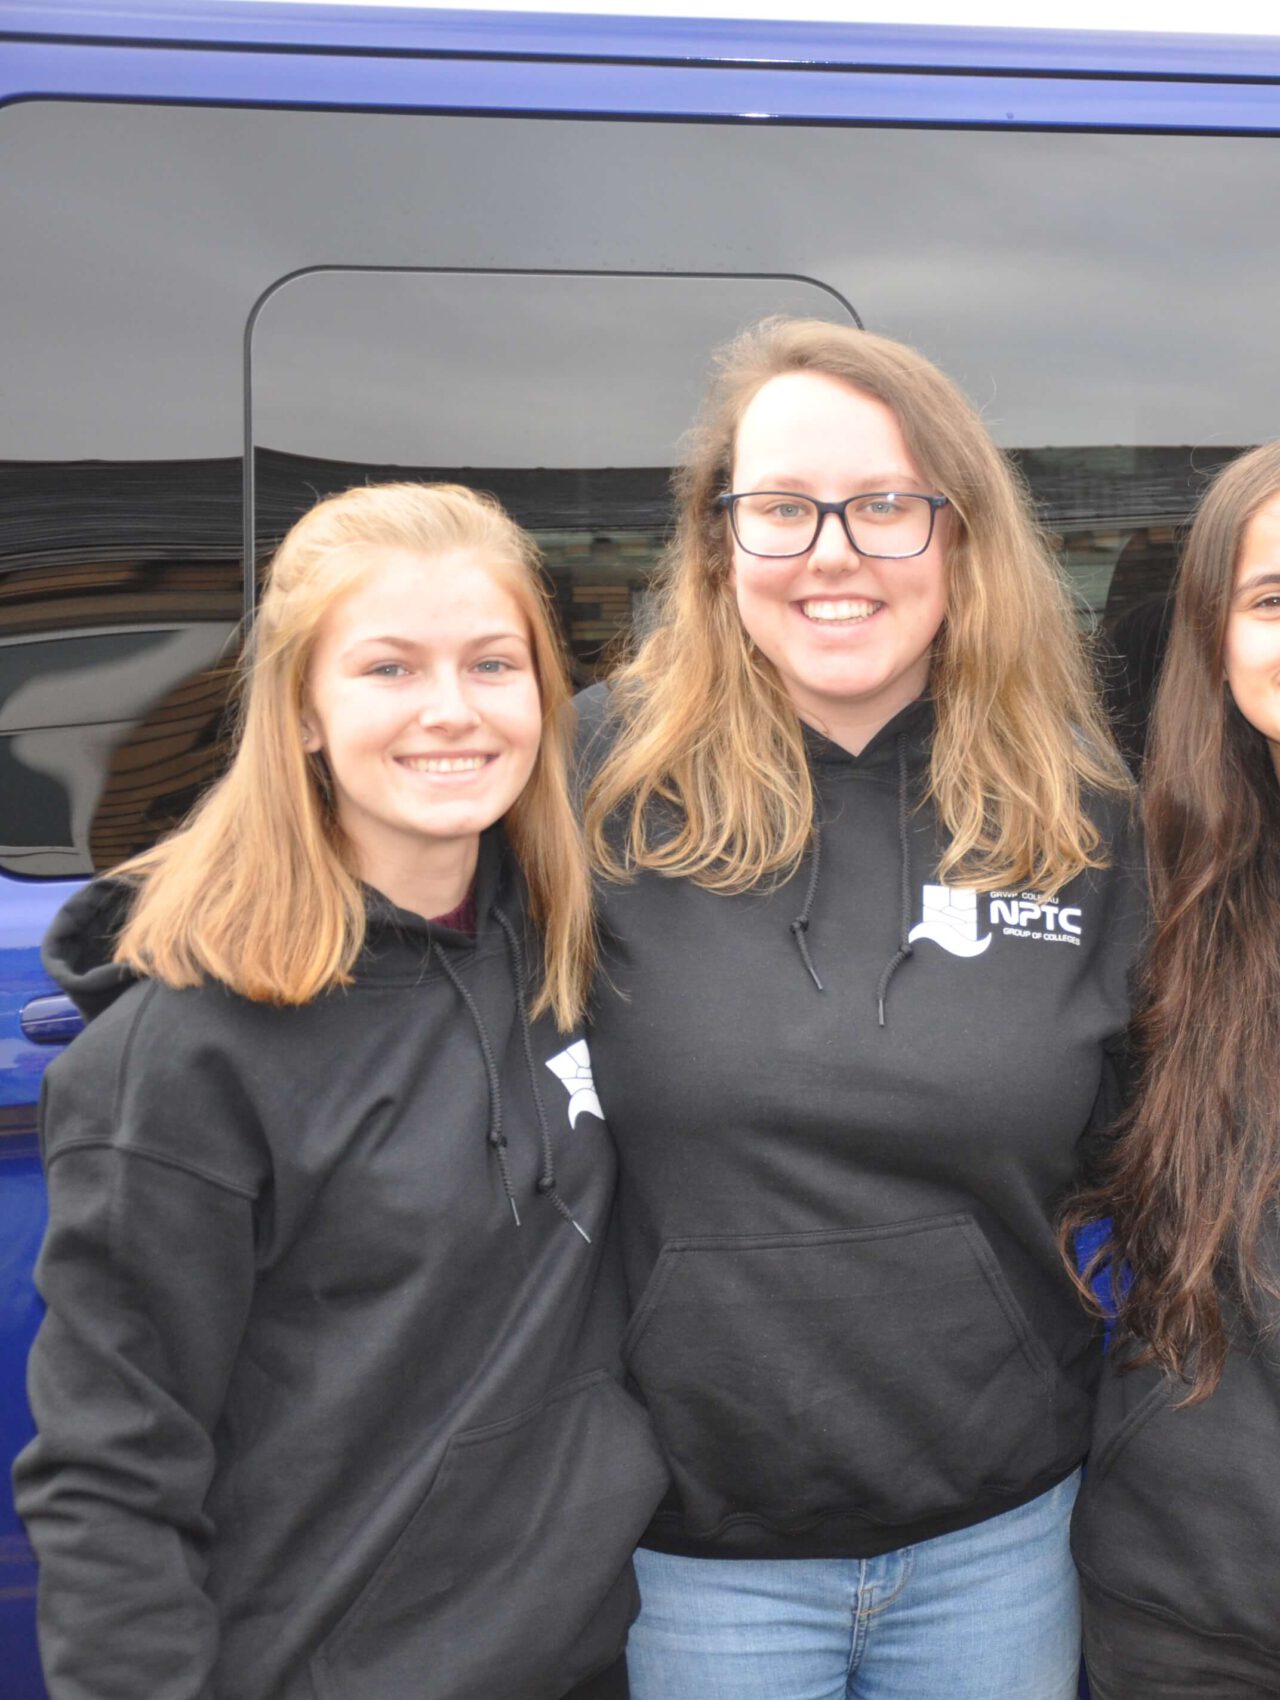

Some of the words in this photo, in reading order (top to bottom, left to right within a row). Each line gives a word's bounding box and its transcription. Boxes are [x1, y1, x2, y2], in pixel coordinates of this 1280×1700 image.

[990, 900, 1082, 935] NPTC
[1003, 927, 1031, 937] GROUP
[1043, 933, 1081, 946] COLLEGES
